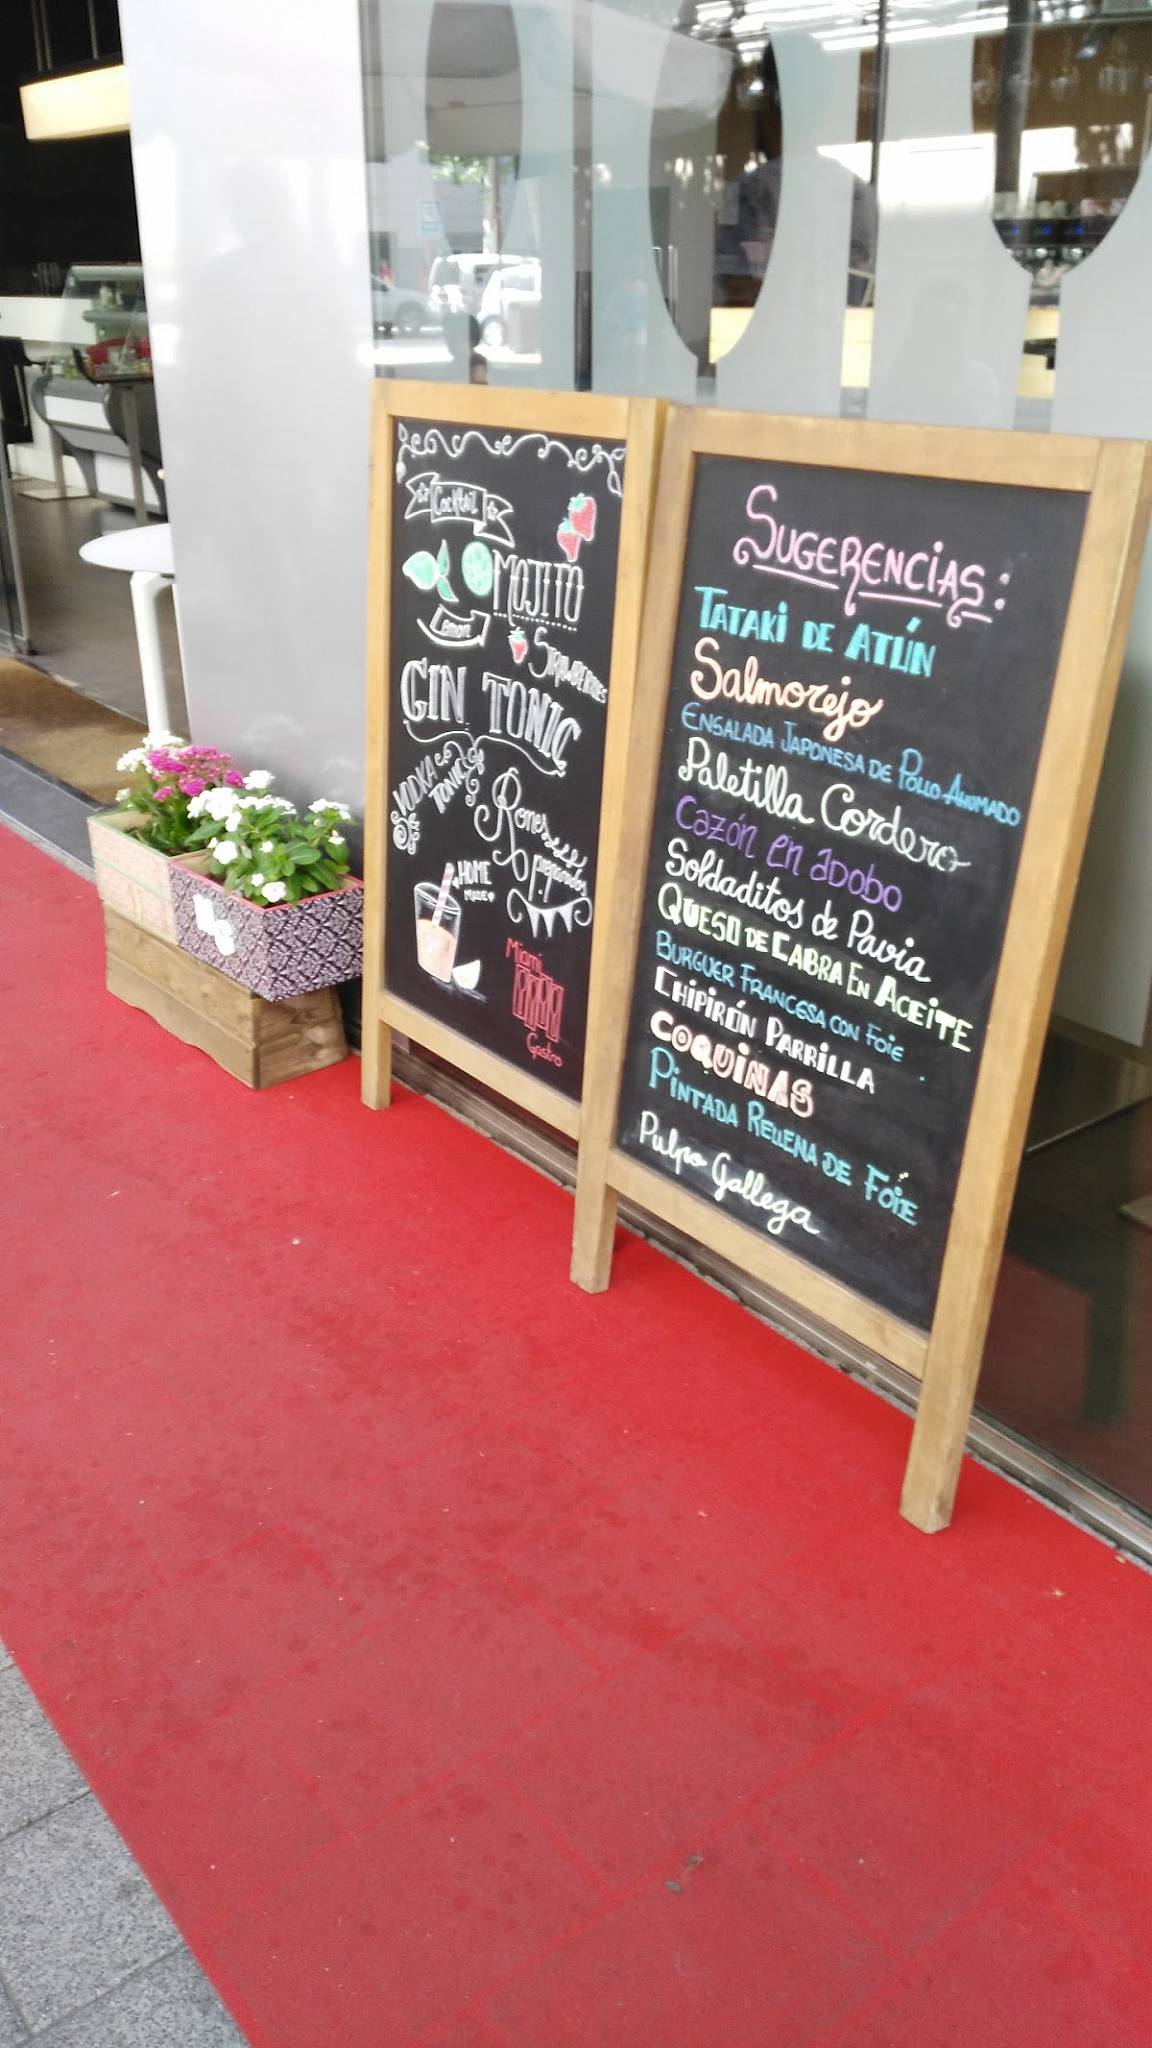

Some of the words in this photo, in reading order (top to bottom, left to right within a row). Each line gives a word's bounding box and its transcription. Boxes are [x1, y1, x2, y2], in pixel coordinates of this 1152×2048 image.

[492, 549, 585, 627] MOJITO
[694, 586, 788, 643] TATAKI
[802, 619, 836, 652] DE
[844, 616, 938, 678] ATÚN
[400, 657, 467, 724] GIN
[482, 671, 583, 771] TONIC
[690, 637, 884, 742] Salmorejo
[392, 755, 439, 817] VODKA
[678, 736, 815, 824] Paletilla
[820, 783, 971, 874] Cordero
[681, 702, 776, 751] ENSALADA
[780, 719, 866, 775] JAPONESA
[868, 759, 893, 783] DE
[898, 747, 942, 800] POLLO
[943, 772, 1022, 827] AHUMADO
[457, 860, 492, 885] HOME
[664, 837, 805, 930] Soldaditos
[812, 899, 838, 940] de
[674, 795, 759, 859] Cazón
[766, 833, 803, 876] en
[655, 929, 735, 988] BURGUER
[740, 963, 827, 1028] FRANCESA
[828, 1014, 860, 1041] CON
[864, 1023, 905, 1063] FOIE
[657, 882, 741, 947] QUESO
[744, 927, 769, 952] DE
[771, 930, 843, 986] CABRA
[873, 974, 974, 1052] ACEITE
[649, 1010, 815, 1118] COQUINAS
[653, 965, 758, 1039] CHIPIRÓN
[764, 1016, 875, 1094] PARRILLA
[649, 1046, 739, 1127] PINTADA
[747, 1100, 818, 1167] RELLENA
[821, 1151, 852, 1186] DE
[638, 1109, 708, 1175] Pulpo
[711, 1152, 821, 1235] Gallega
